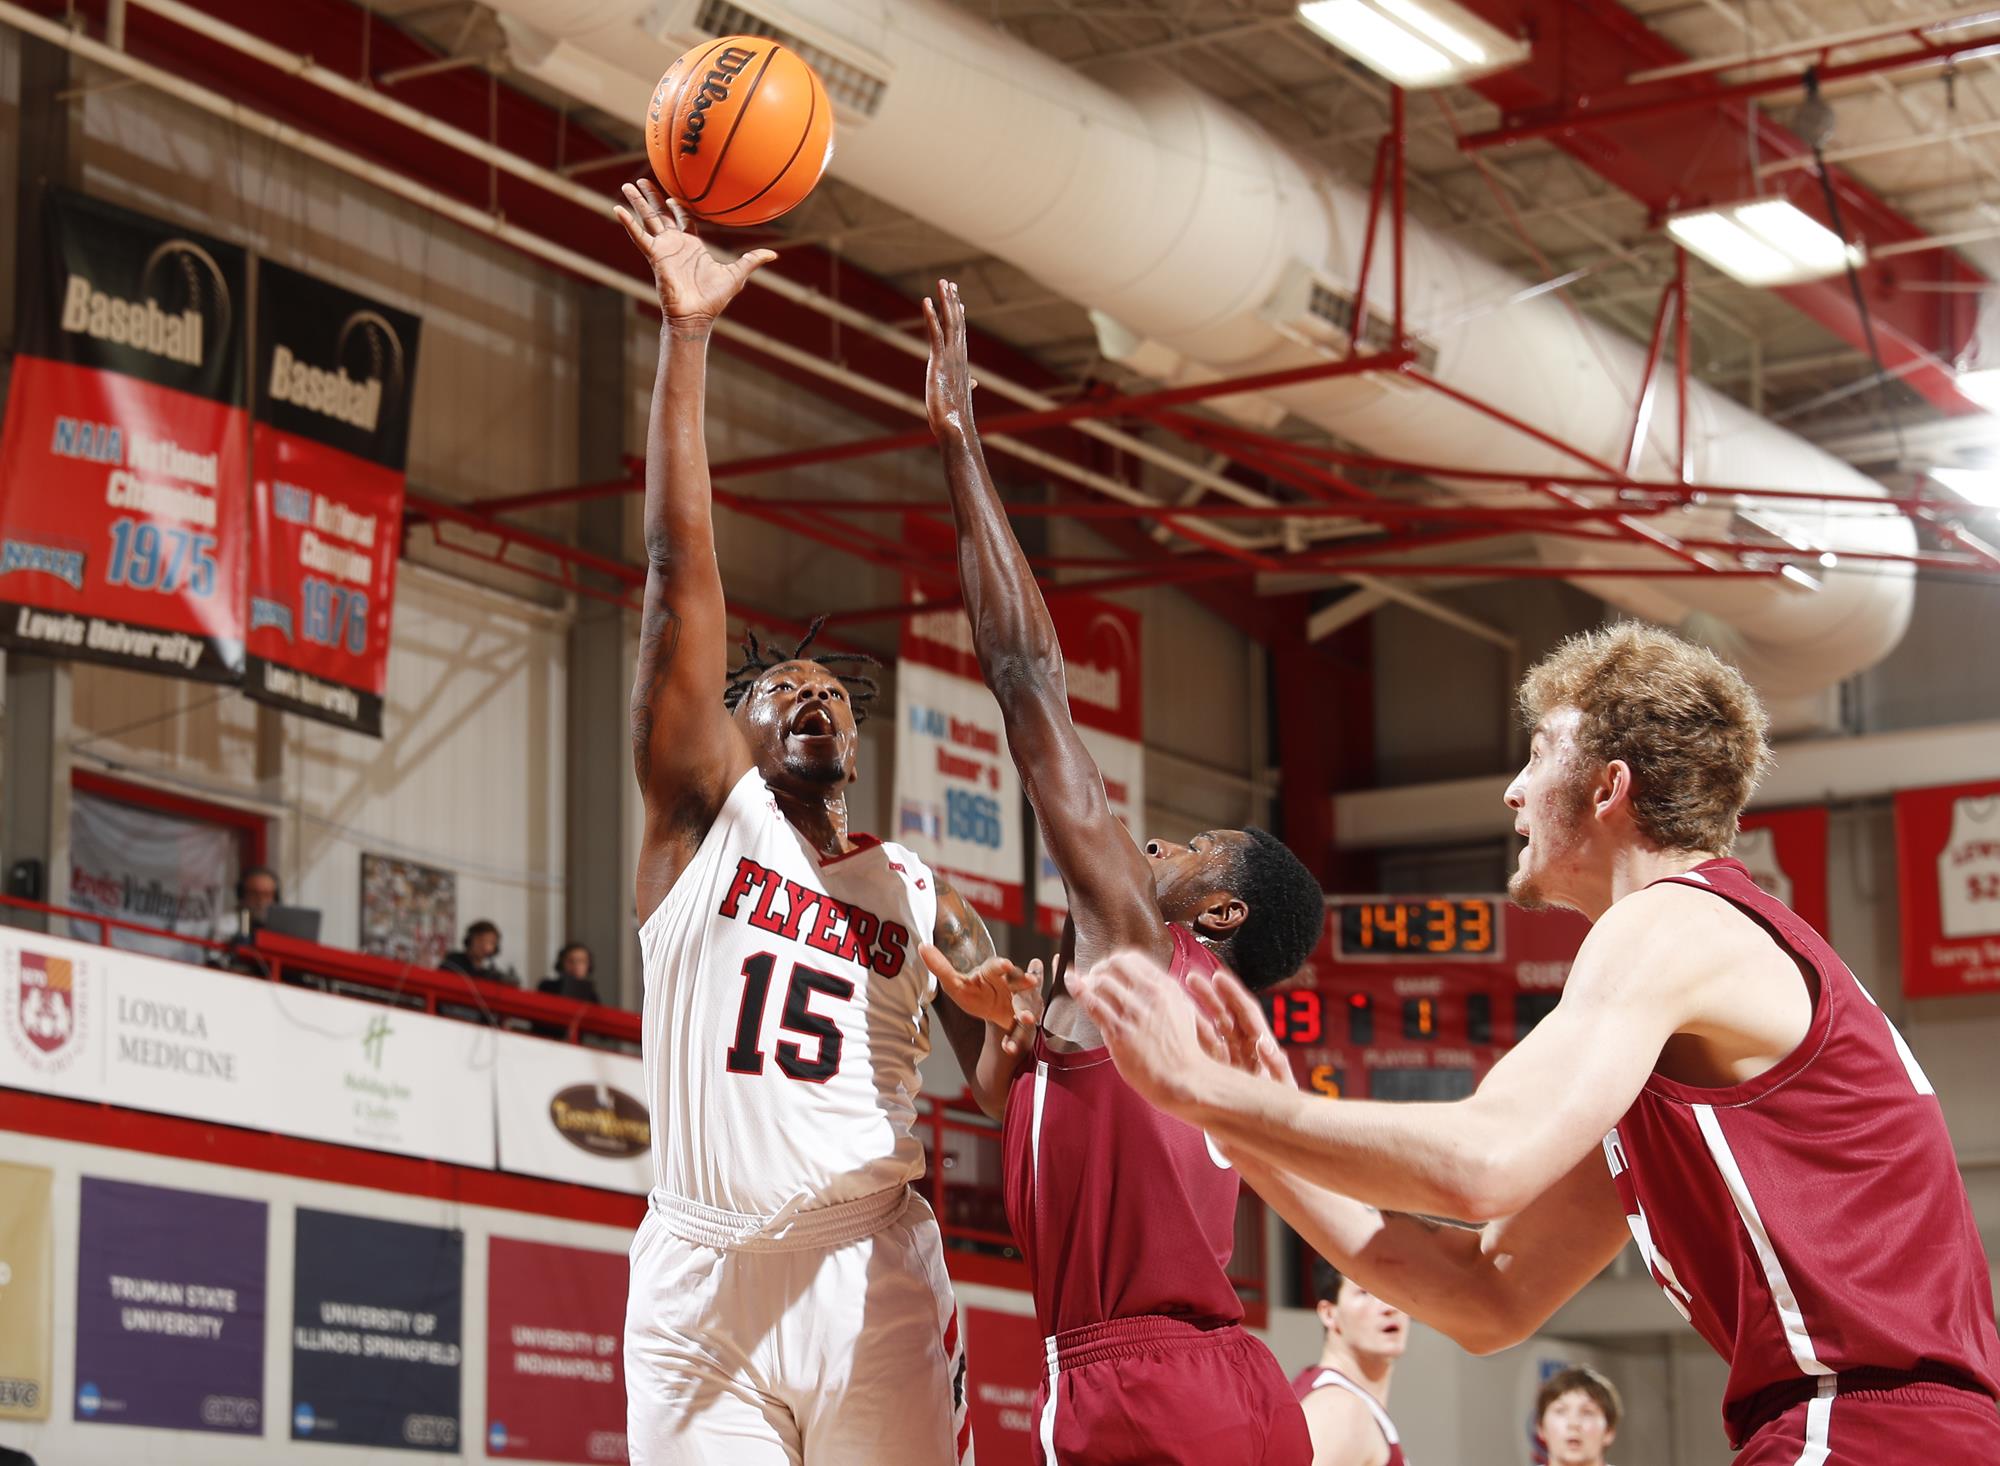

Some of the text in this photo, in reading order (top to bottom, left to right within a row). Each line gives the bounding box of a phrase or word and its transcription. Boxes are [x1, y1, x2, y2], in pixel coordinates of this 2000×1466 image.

[681, 47, 759, 155] Wilson
[61, 274, 204, 366] Baseball
[269, 344, 382, 432] Baseball
[51, 416, 218, 487] NAIA National
[106, 469, 217, 528] Champion
[106, 519, 216, 597] 1975
[16, 608, 204, 668] Lewis University
[302, 576, 368, 654] 1976
[719, 856, 909, 979] FLYERS
[1360, 899, 1492, 952] 14:33
[119, 997, 208, 1041] LOYOLA
[726, 951, 855, 1084] 15
[1272, 991, 1321, 1043] 13
[1418, 999, 1432, 1035] 1
[118, 1034, 237, 1082] MEDICINE
[110, 1275, 237, 1313] TRUMAN STATE
[321, 1302, 436, 1335] UNIVERSITY OF
[121, 1307, 224, 1339] UNIVERSITY
[295, 1327, 460, 1366] ILLINOIS SPRINGFIELD
[512, 1325, 616, 1355] UNIVERSITY OF
